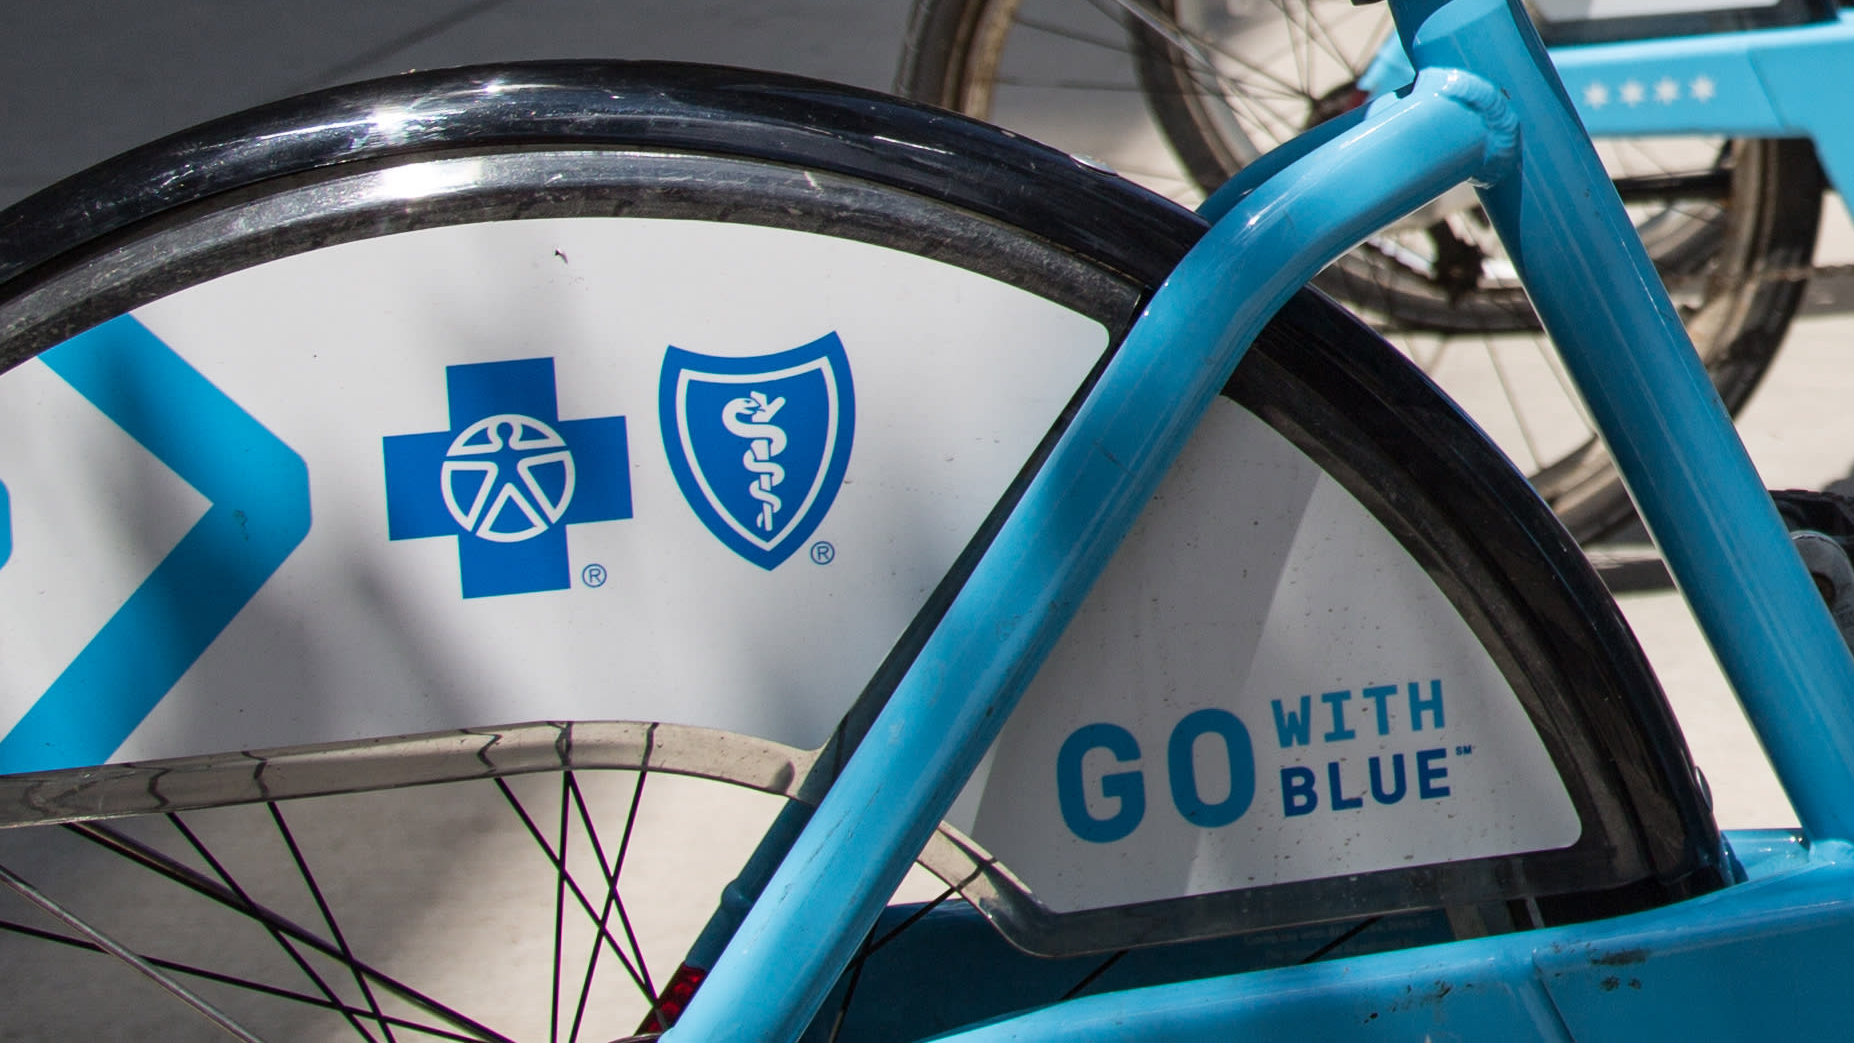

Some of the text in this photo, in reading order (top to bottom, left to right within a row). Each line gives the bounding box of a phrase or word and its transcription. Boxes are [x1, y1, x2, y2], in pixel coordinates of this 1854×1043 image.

[1056, 679, 1446, 843] GO WITH
[1281, 747, 1451, 817] BLUE
